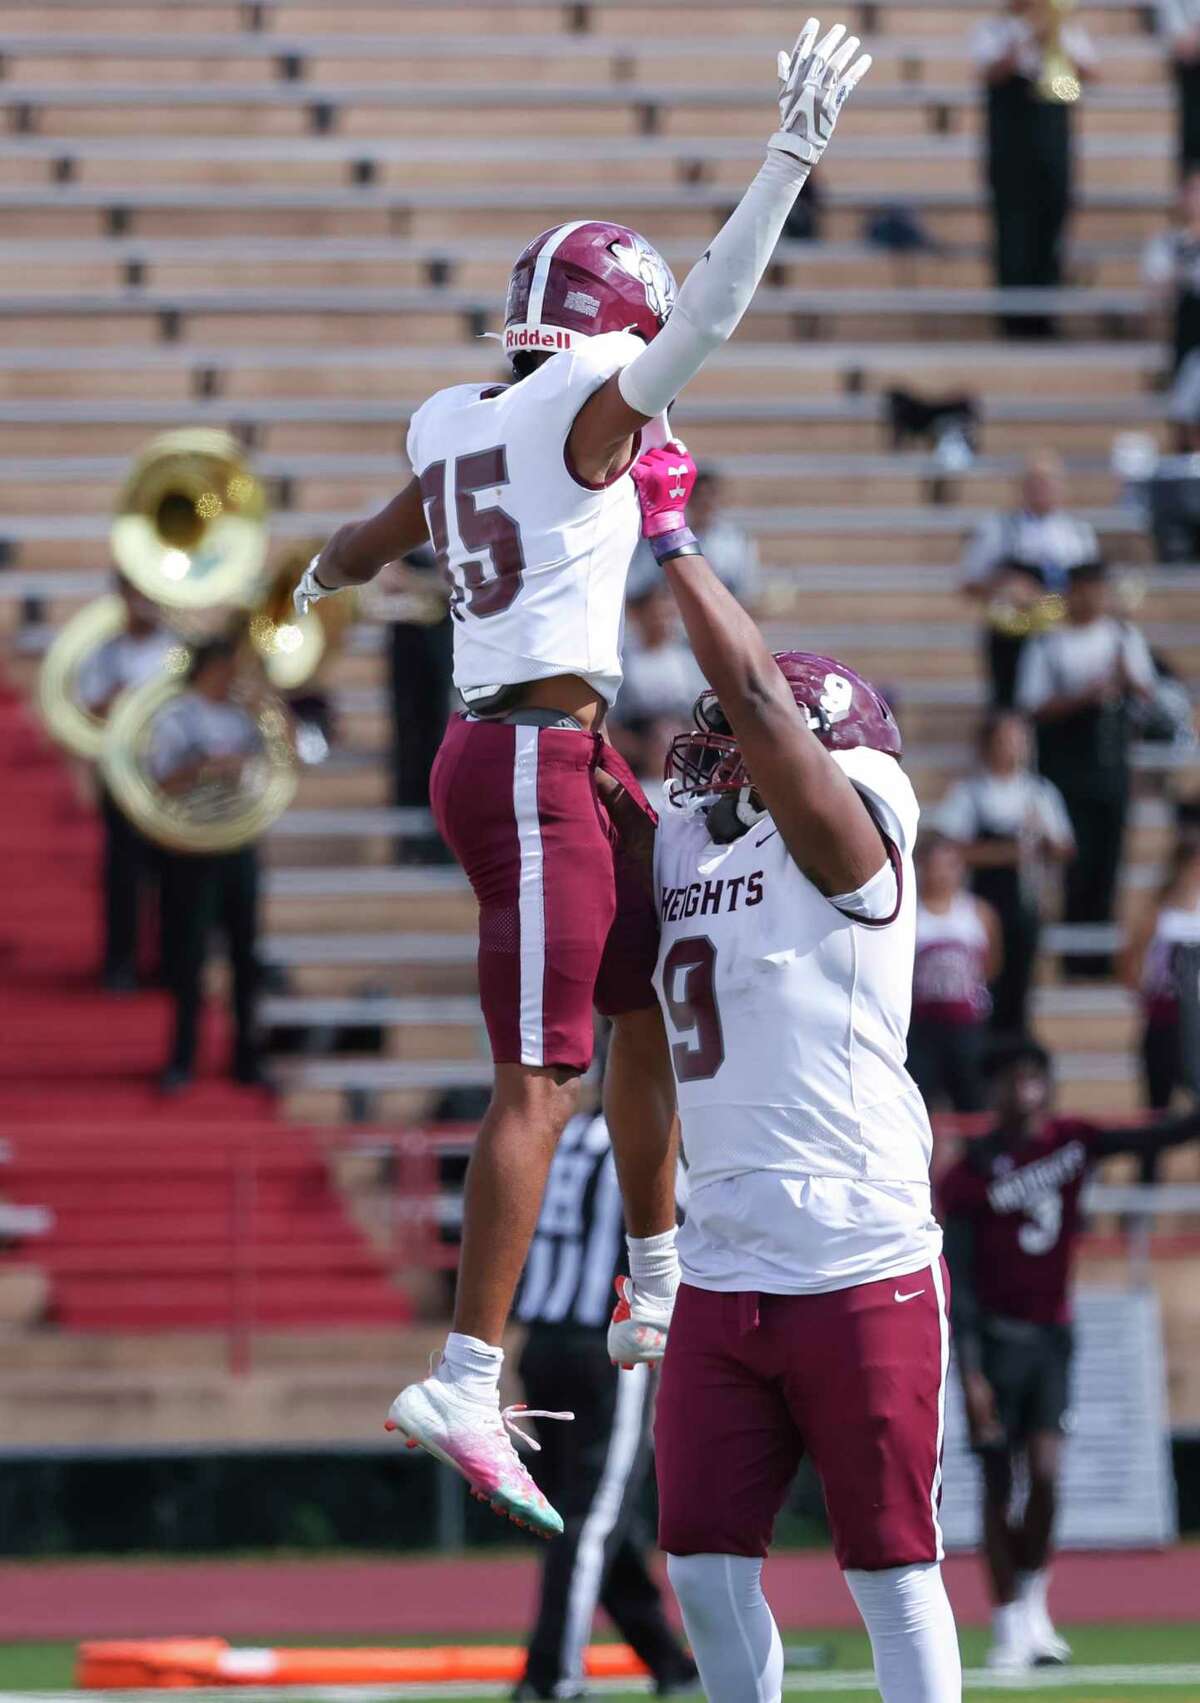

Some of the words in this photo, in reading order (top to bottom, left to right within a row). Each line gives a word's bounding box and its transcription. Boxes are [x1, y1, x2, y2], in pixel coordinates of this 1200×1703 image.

[505, 330, 571, 349] Riddell
[420, 444, 527, 621] 15
[661, 870, 764, 922] HEIGHTS
[662, 934, 726, 1083] 9
